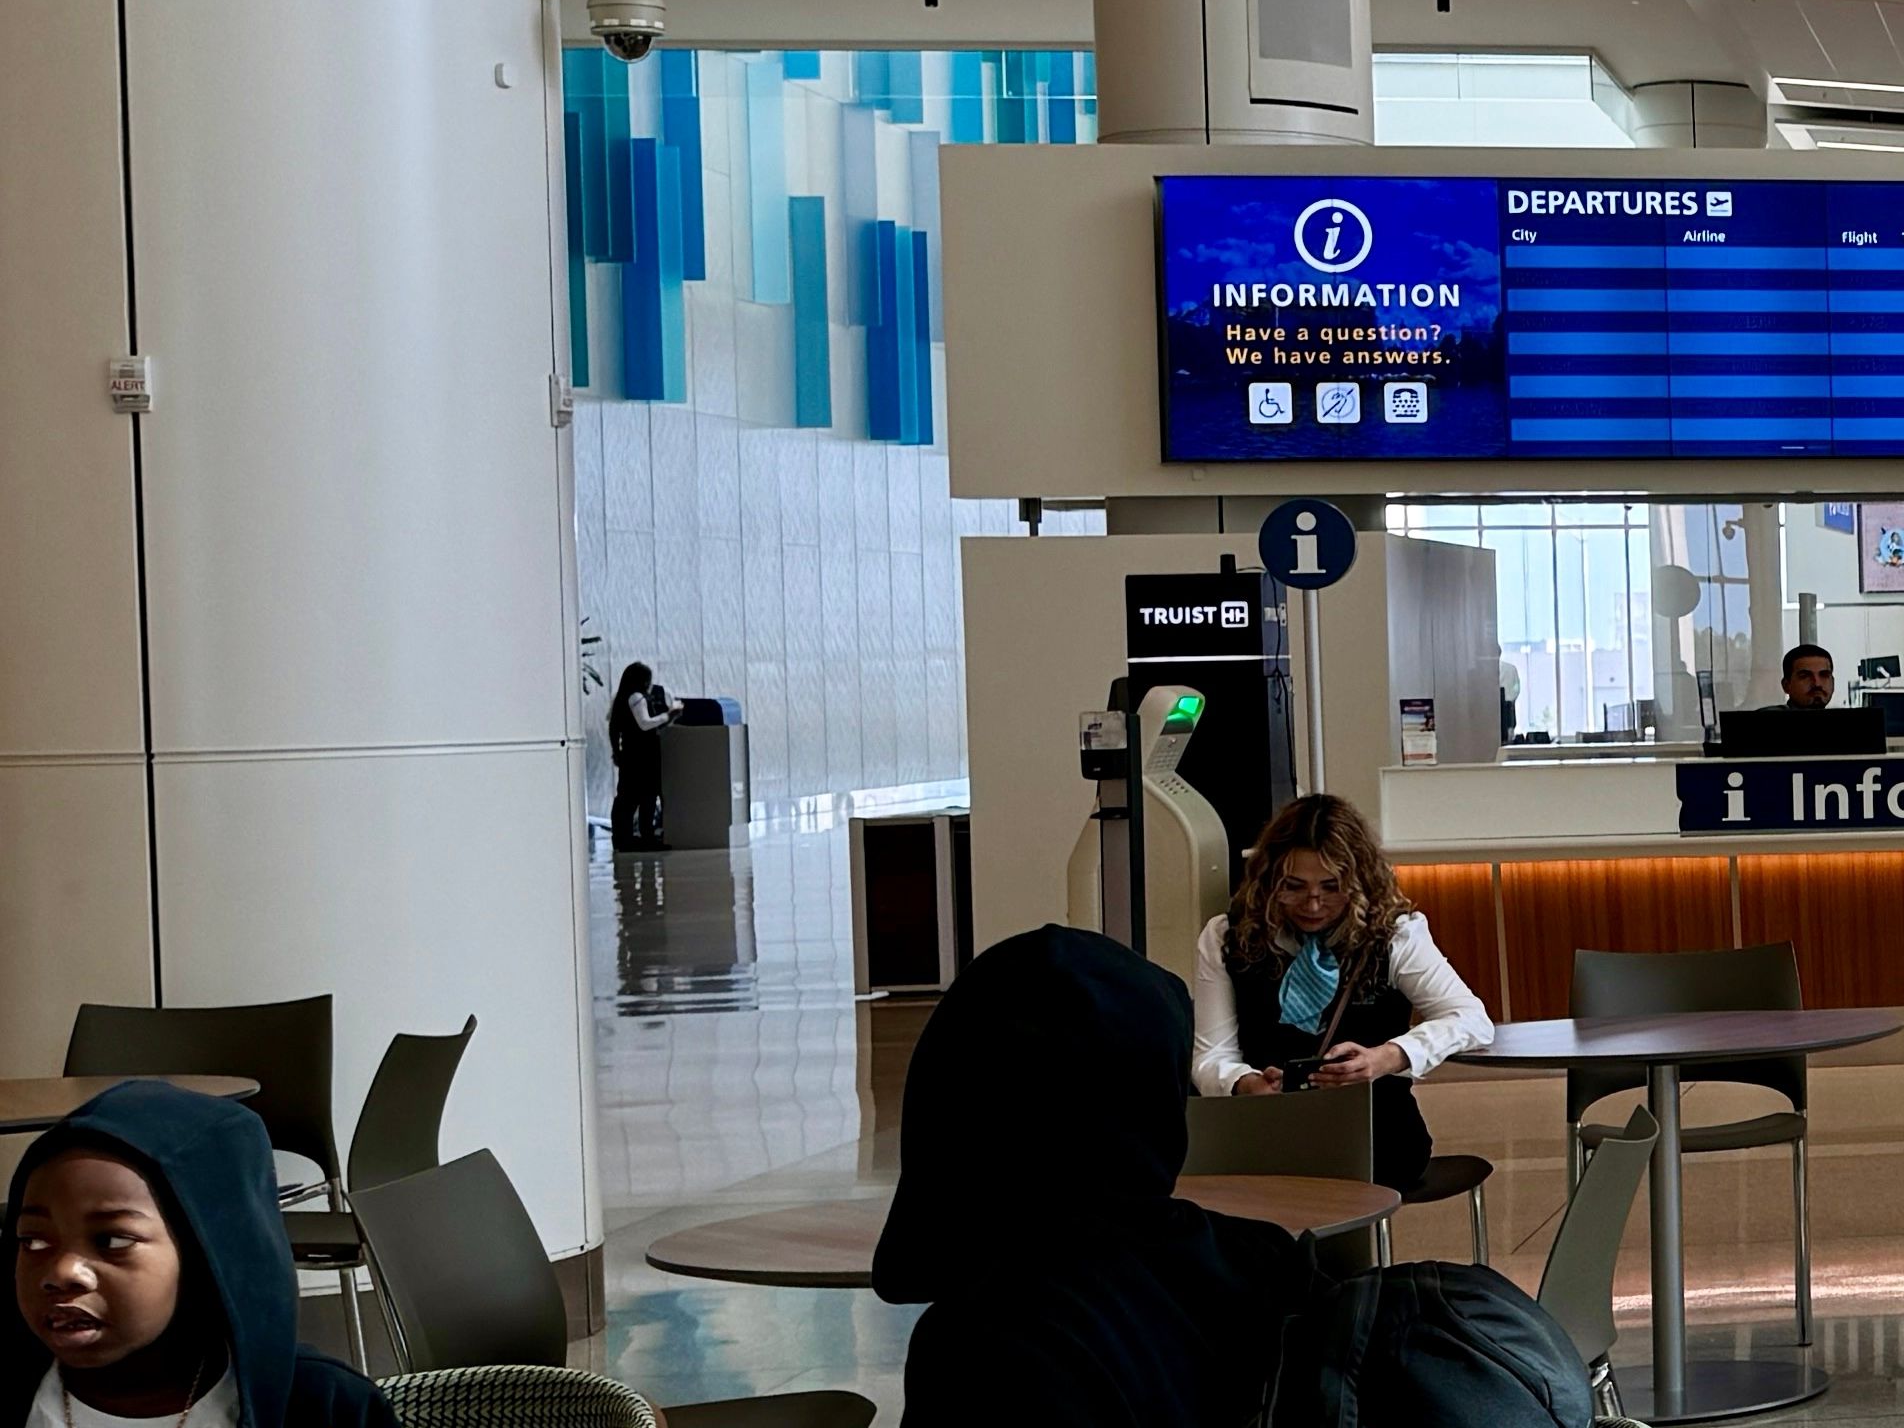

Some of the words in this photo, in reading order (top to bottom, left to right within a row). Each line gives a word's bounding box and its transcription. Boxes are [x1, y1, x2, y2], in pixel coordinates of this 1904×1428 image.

[1507, 190, 1699, 216] DEPARTURES
[1511, 228, 1538, 245] City
[1683, 229, 1726, 243] Airline
[1841, 230, 1878, 246] Flight
[1213, 283, 1460, 307] INFORMATION
[1226, 324, 1286, 341] Have
[1297, 327, 1309, 341] a
[1320, 323, 1441, 345] question?
[1226, 347, 1263, 365] We
[1274, 347, 1330, 364] have
[1342, 351, 1450, 365] answers.
[1139, 606, 1218, 625] TRUIST
